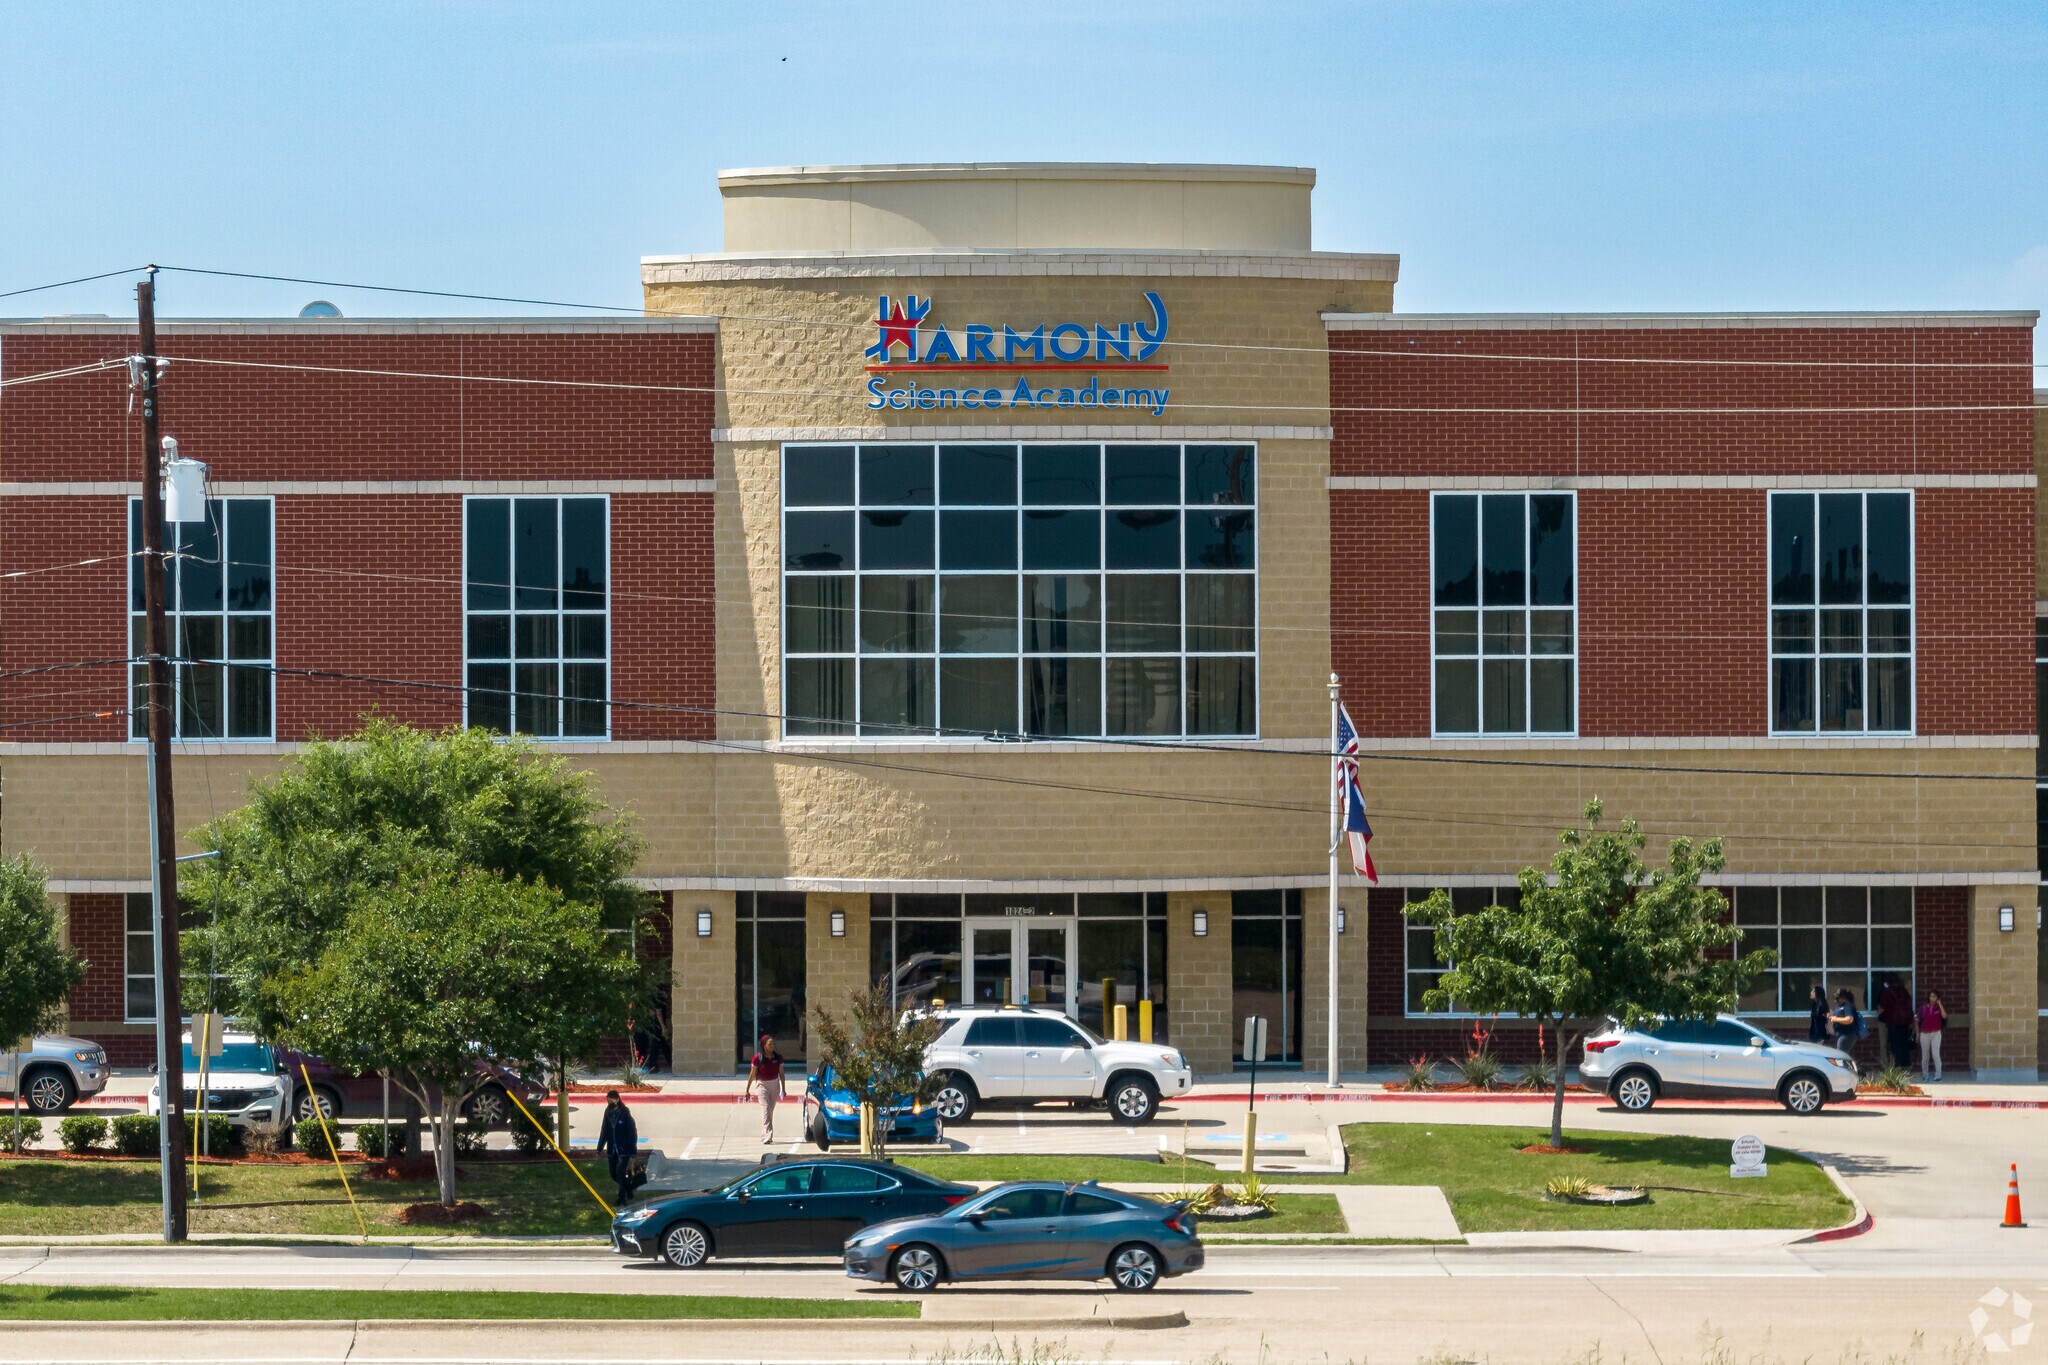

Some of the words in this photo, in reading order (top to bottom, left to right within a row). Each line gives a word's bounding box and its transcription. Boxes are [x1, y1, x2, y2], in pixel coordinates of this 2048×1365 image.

[865, 291, 1169, 363] HARMONY
[867, 377, 1003, 410] Science
[1009, 376, 1170, 417] Academy
